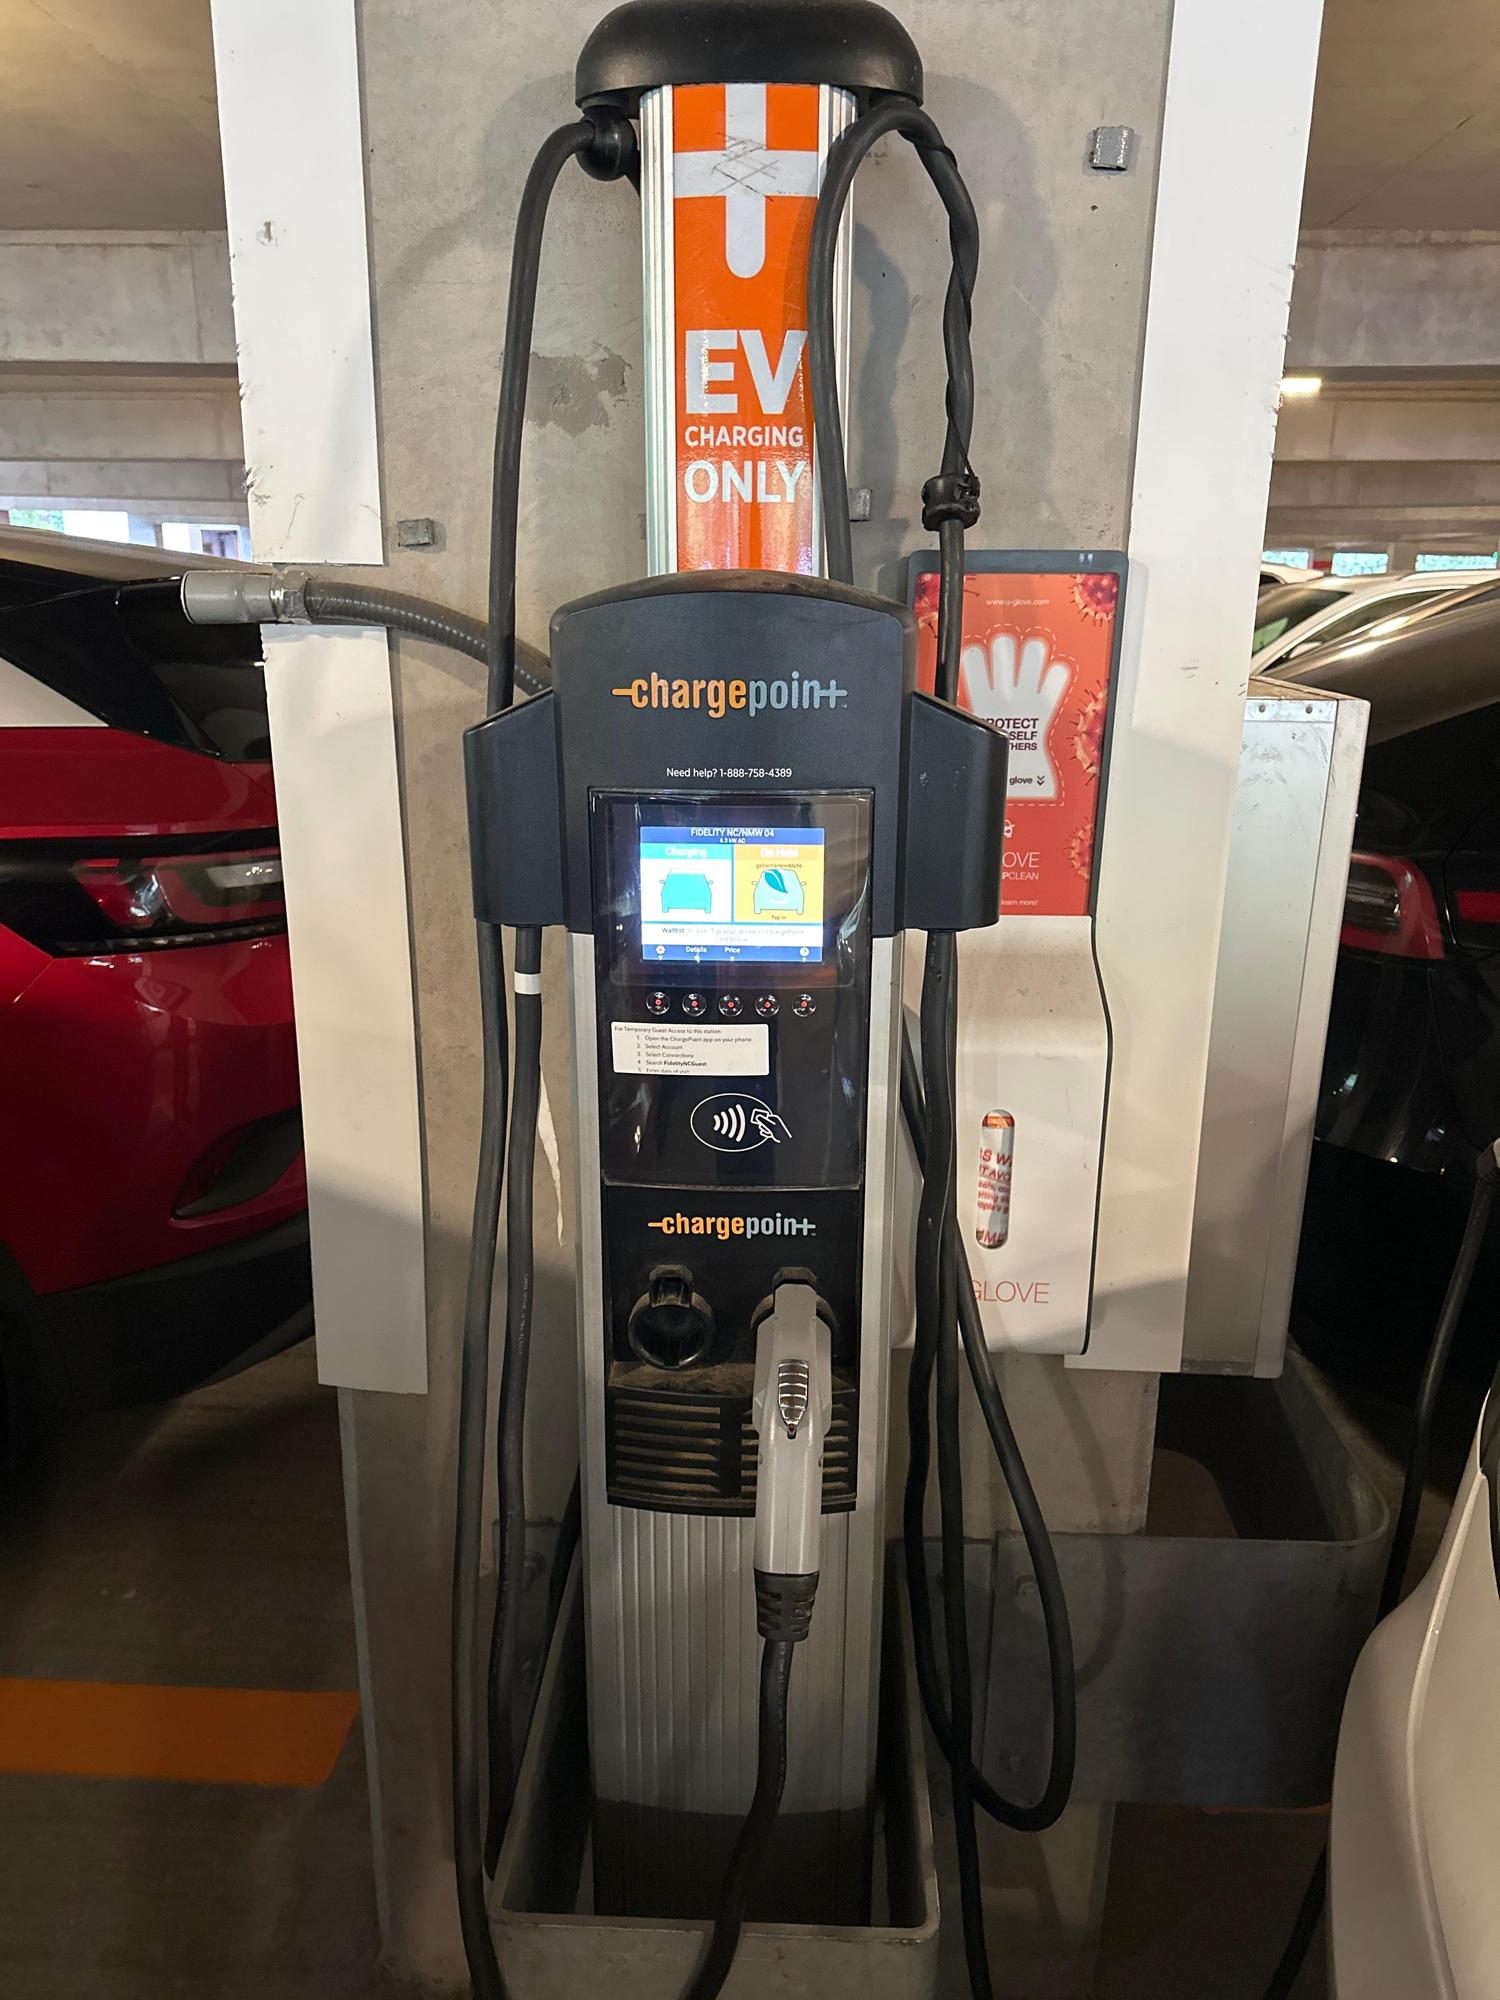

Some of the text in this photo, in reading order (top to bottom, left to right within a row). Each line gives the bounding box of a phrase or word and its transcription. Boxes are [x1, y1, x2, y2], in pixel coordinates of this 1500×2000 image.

[685, 329, 808, 415] EV
[685, 425, 804, 447] CHARGING
[684, 460, 808, 503] ONLY
[986, 598, 1050, 607] www.u-glove.com
[984, 718, 1039, 729] ROTECT
[1008, 731, 1038, 741] SELF
[666, 768, 792, 780] Need help? 1-888-758-4389
[1009, 776, 1033, 785] glove
[690, 828, 775, 838] FIDELITY NC/NMW 04
